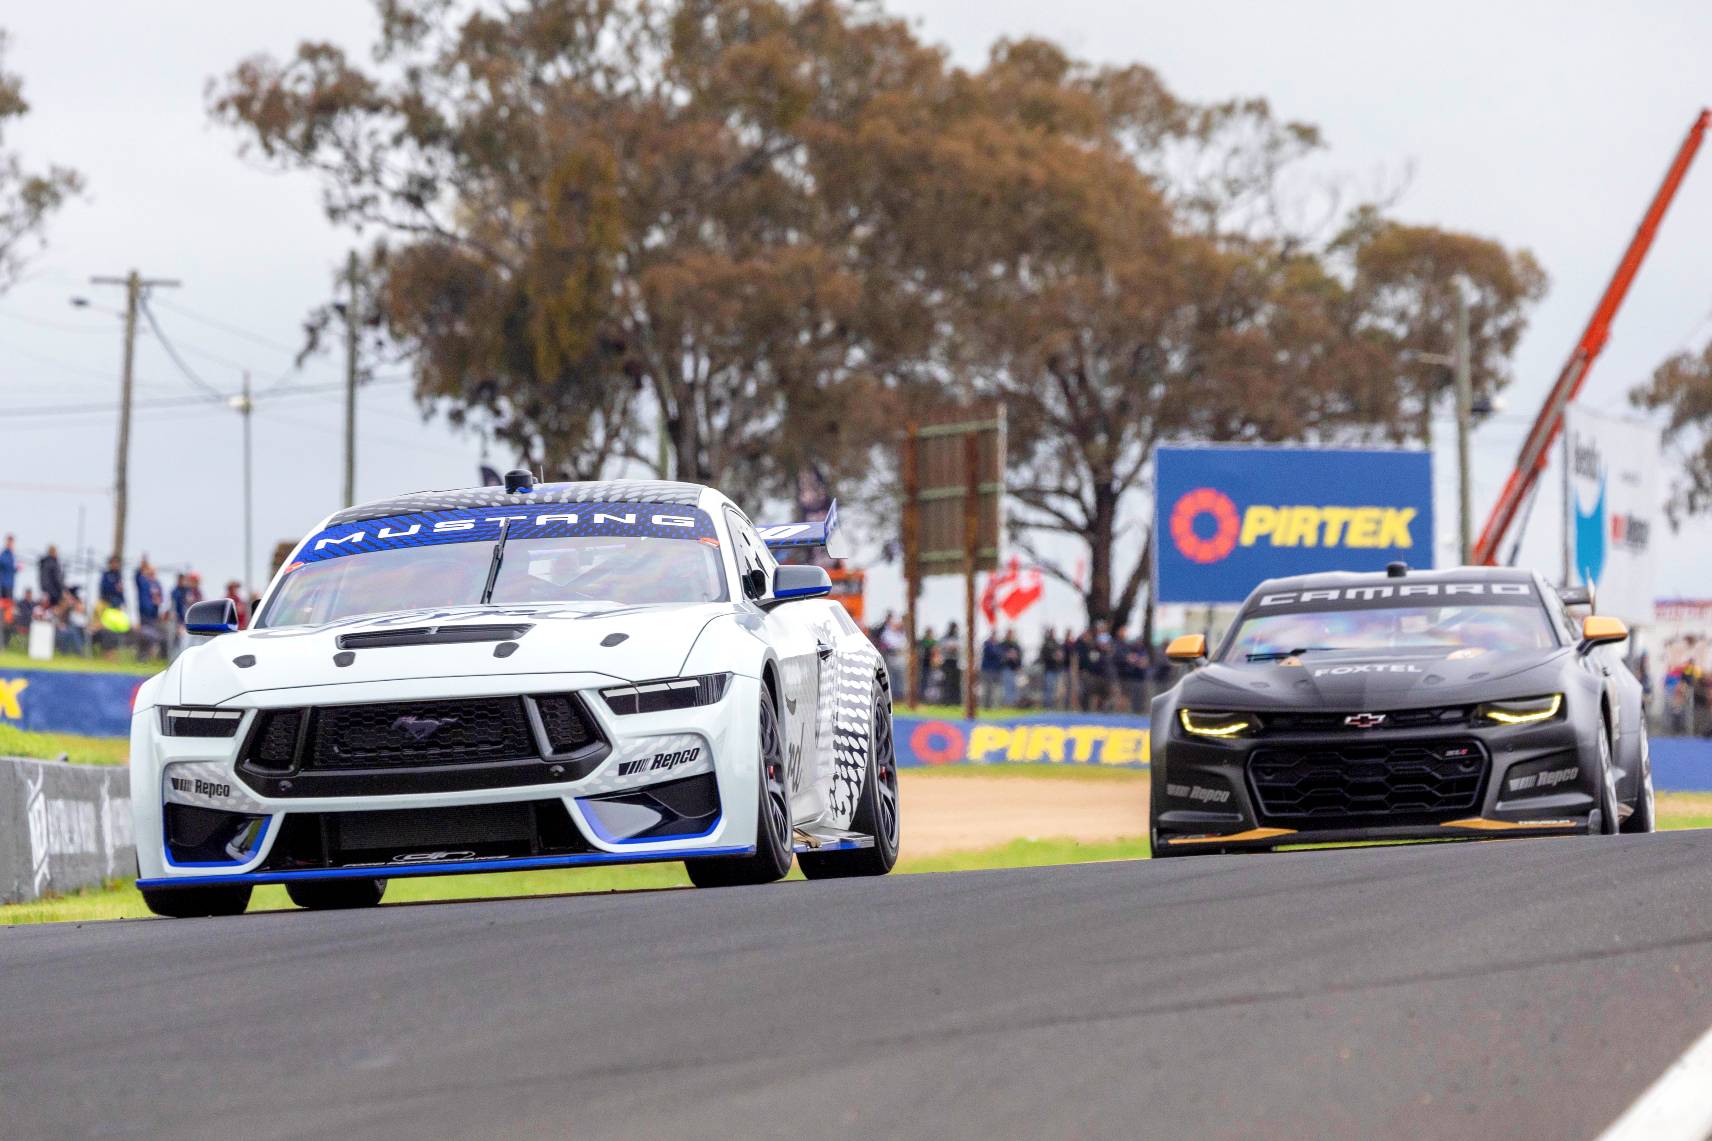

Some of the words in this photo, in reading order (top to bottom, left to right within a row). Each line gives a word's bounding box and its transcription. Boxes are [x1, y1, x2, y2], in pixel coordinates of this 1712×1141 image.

[314, 513, 695, 551] MUSTANG
[1239, 505, 1418, 548] PIRTEK
[1260, 583, 1530, 606] CAMARO
[1313, 663, 1424, 677] FOXTEL
[966, 724, 1150, 764] PIRTE
[649, 747, 700, 770] Repco
[1537, 766, 1579, 786] Repco
[194, 779, 230, 798] Repco
[1190, 786, 1230, 803] Repco
